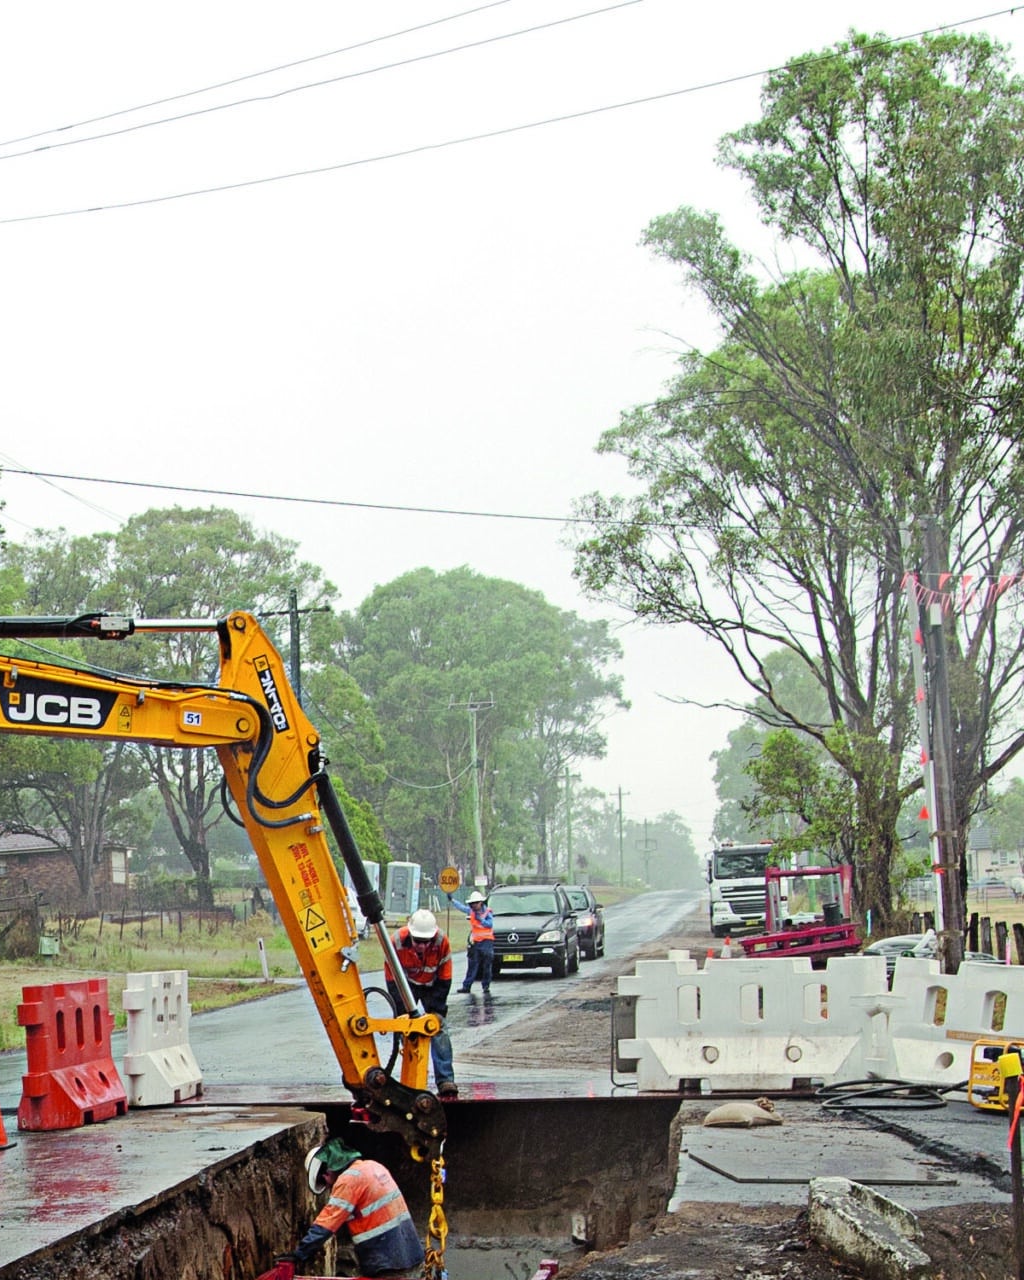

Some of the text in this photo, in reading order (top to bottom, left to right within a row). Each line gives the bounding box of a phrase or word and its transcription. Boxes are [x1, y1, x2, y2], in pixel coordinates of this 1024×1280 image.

[8, 693, 102, 726] JCB
[186, 713, 201, 724] 51
[441, 875, 458, 885] SLOW
